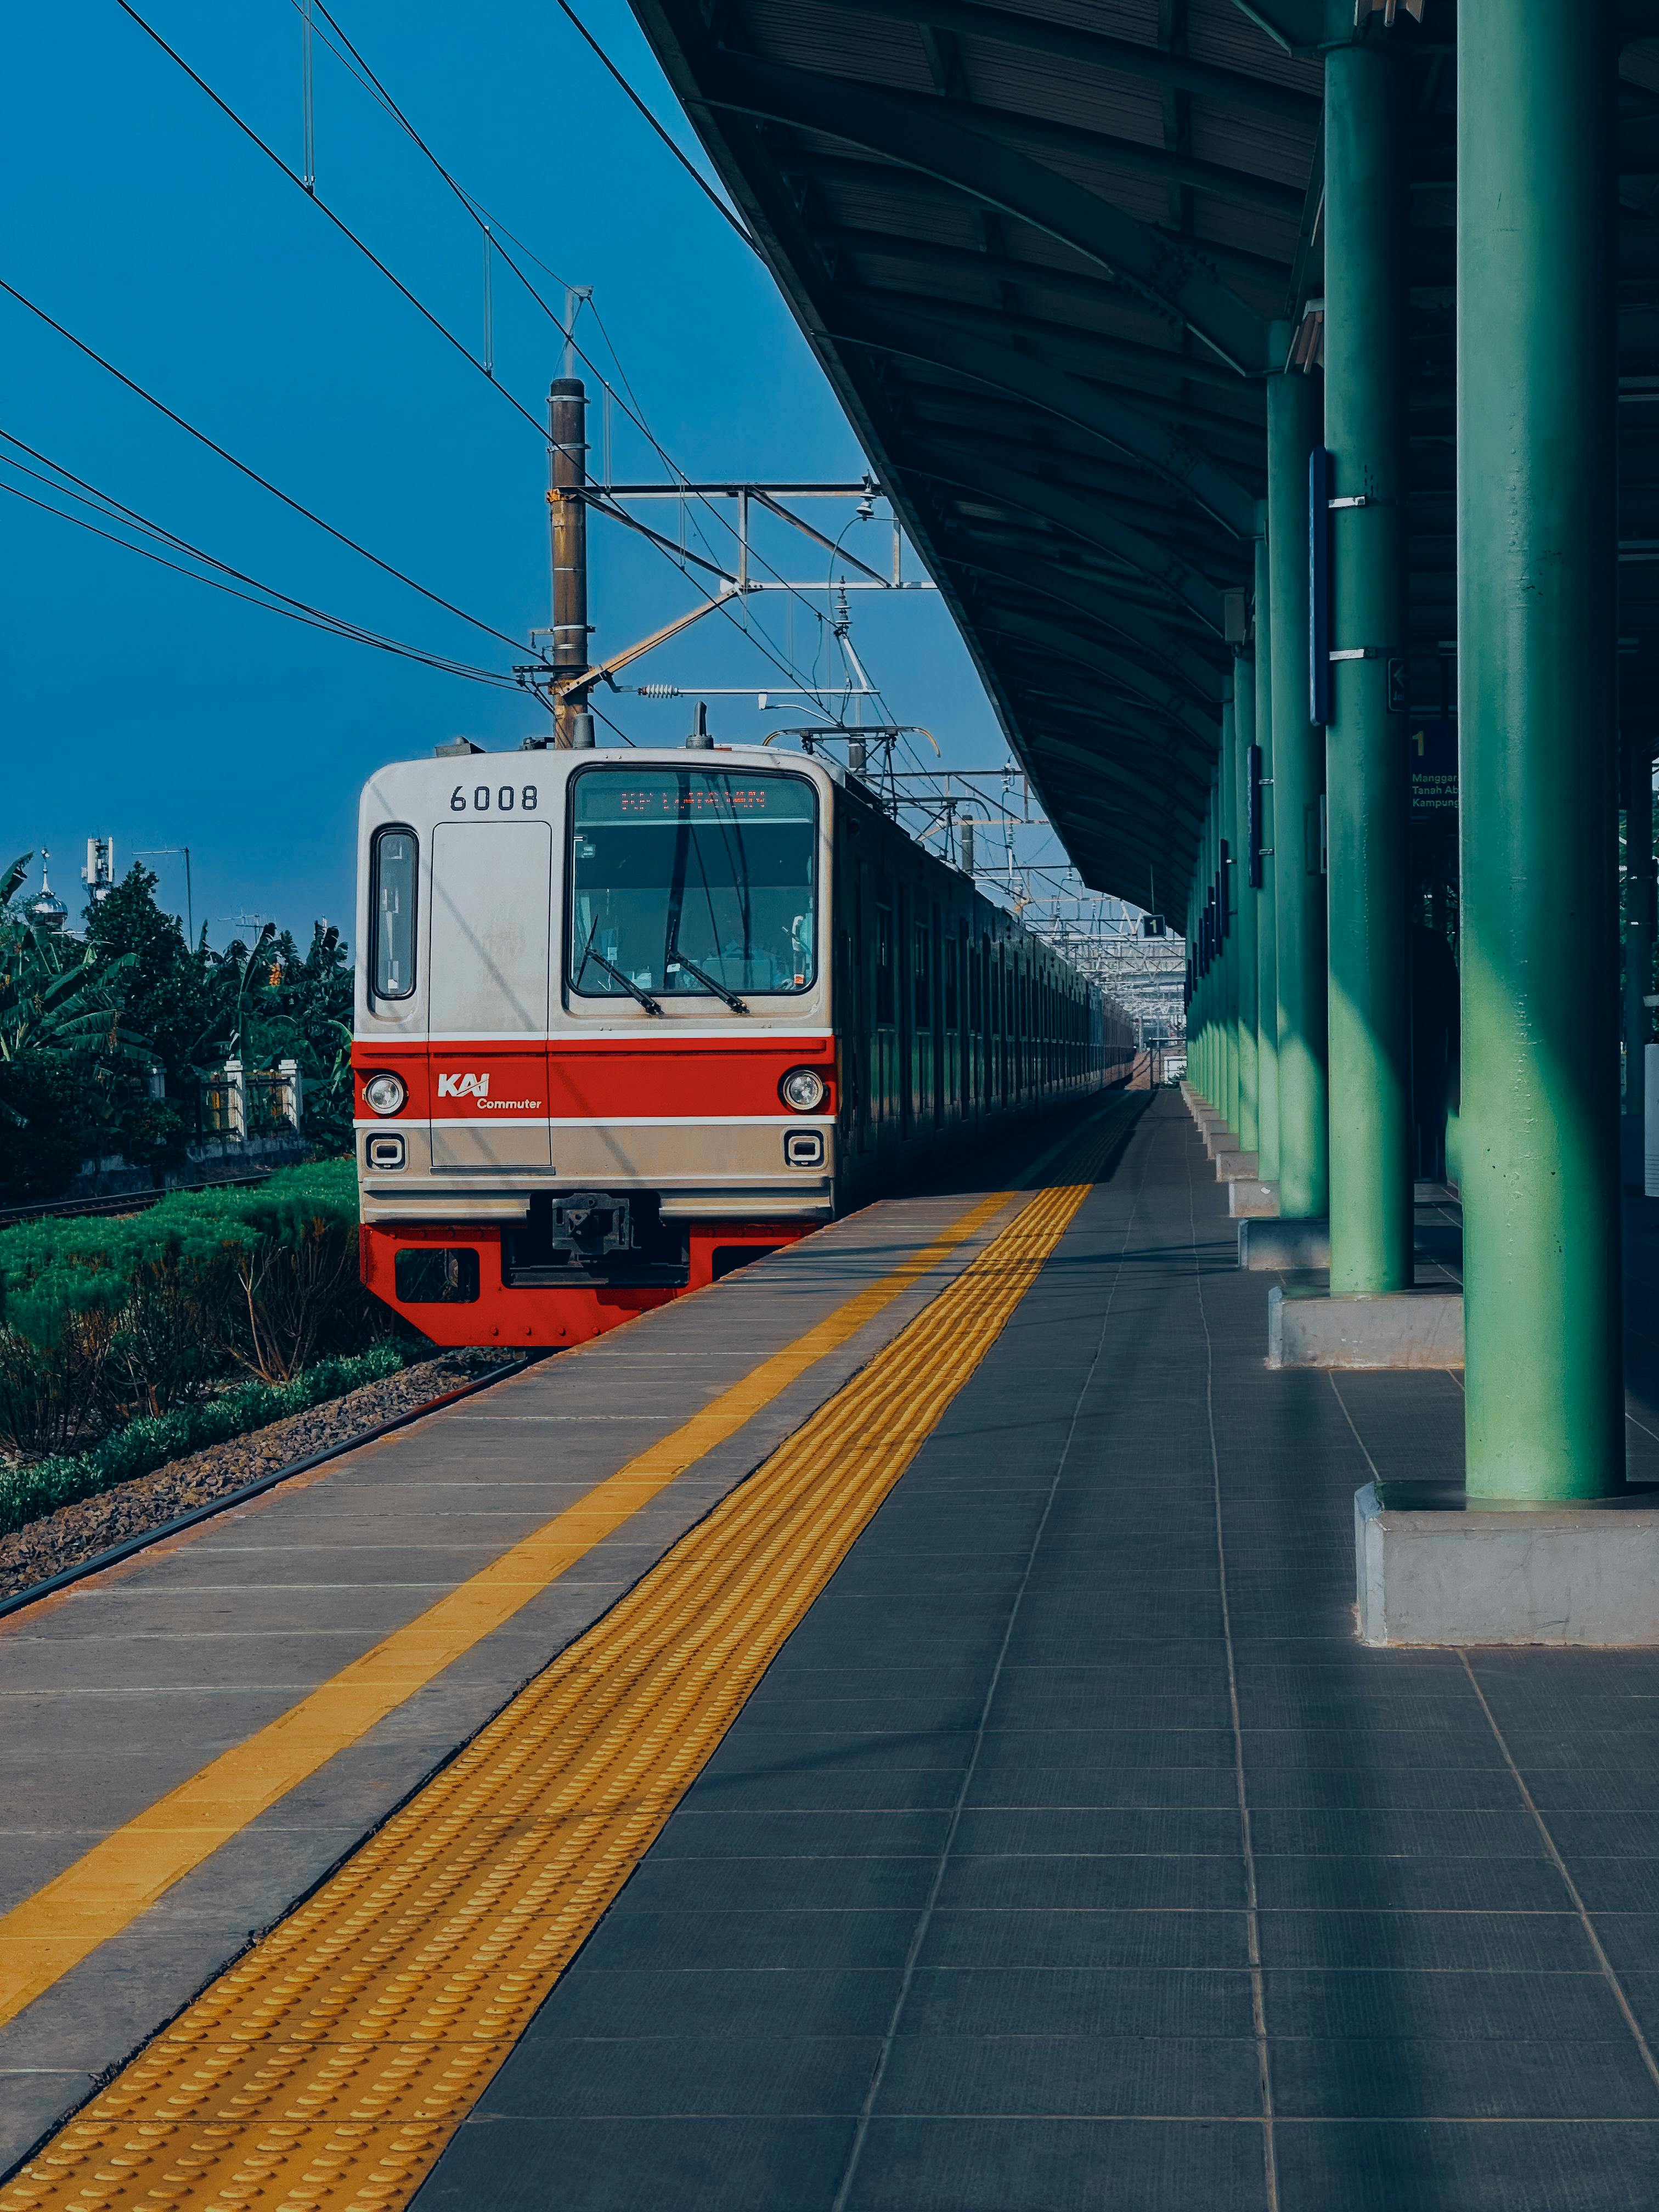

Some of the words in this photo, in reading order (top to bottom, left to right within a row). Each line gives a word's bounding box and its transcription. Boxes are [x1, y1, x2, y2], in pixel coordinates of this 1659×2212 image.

[1412, 730, 1425, 757] 1
[1412, 773, 1458, 784] Manggar
[1412, 785, 1442, 795] Tanah
[450, 785, 537, 811] 6008
[1413, 797, 1459, 809] Kampung
[1149, 919, 1157, 933] 1
[437, 1073, 489, 1097] KAI
[477, 1098, 541, 1109] Commuter
